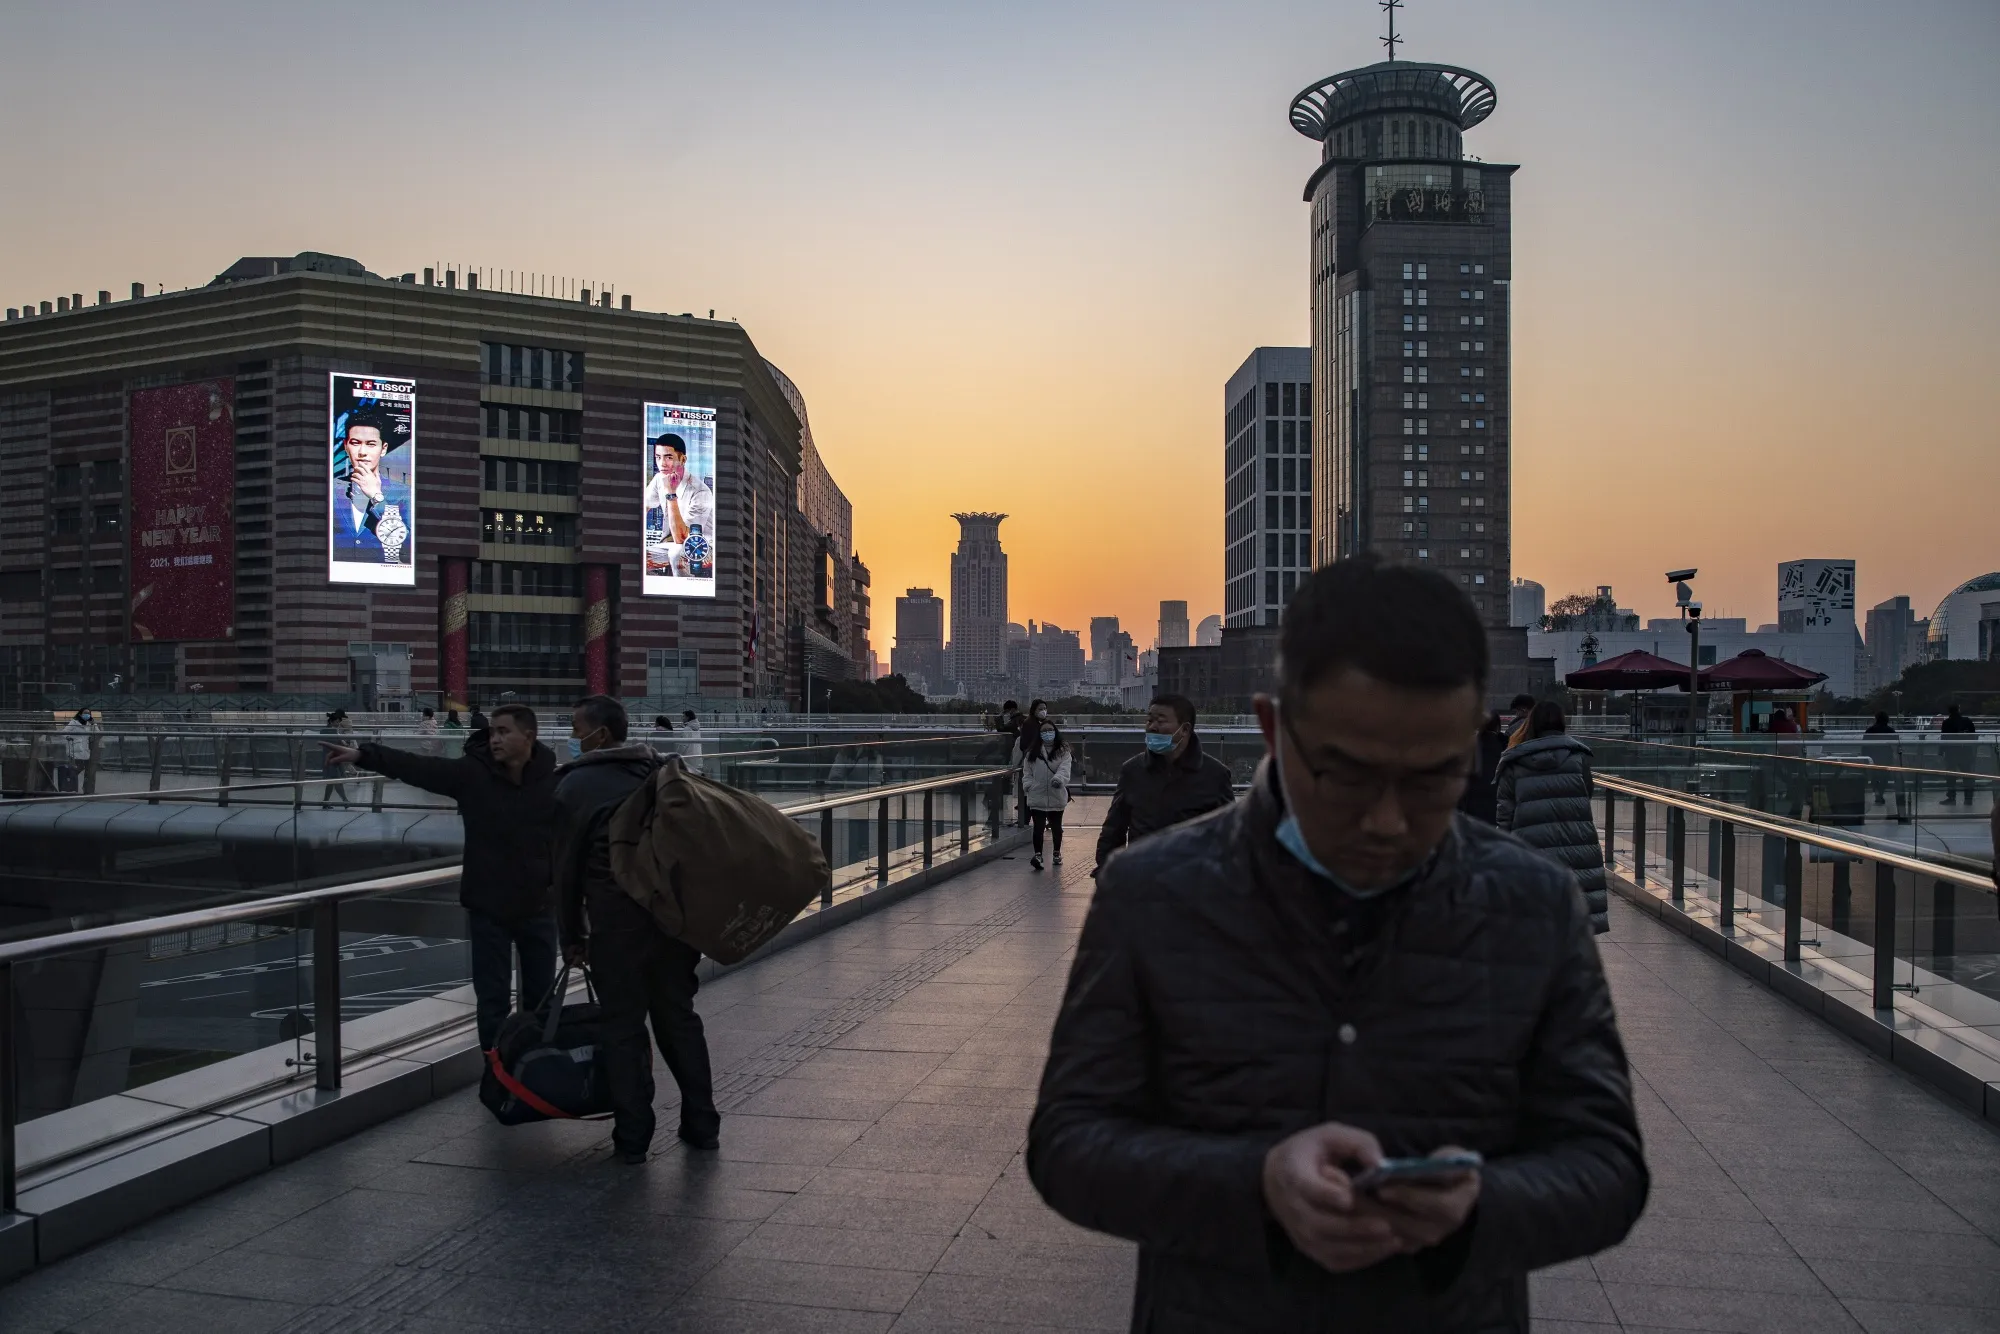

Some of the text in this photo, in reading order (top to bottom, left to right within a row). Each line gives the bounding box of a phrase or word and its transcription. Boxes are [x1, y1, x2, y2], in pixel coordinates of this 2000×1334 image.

[374, 383, 412, 393] TISSOT
[681, 412, 714, 420] TISSOT
[155, 506, 206, 525] HAPPY
[142, 526, 221, 546] NEW YEAR
